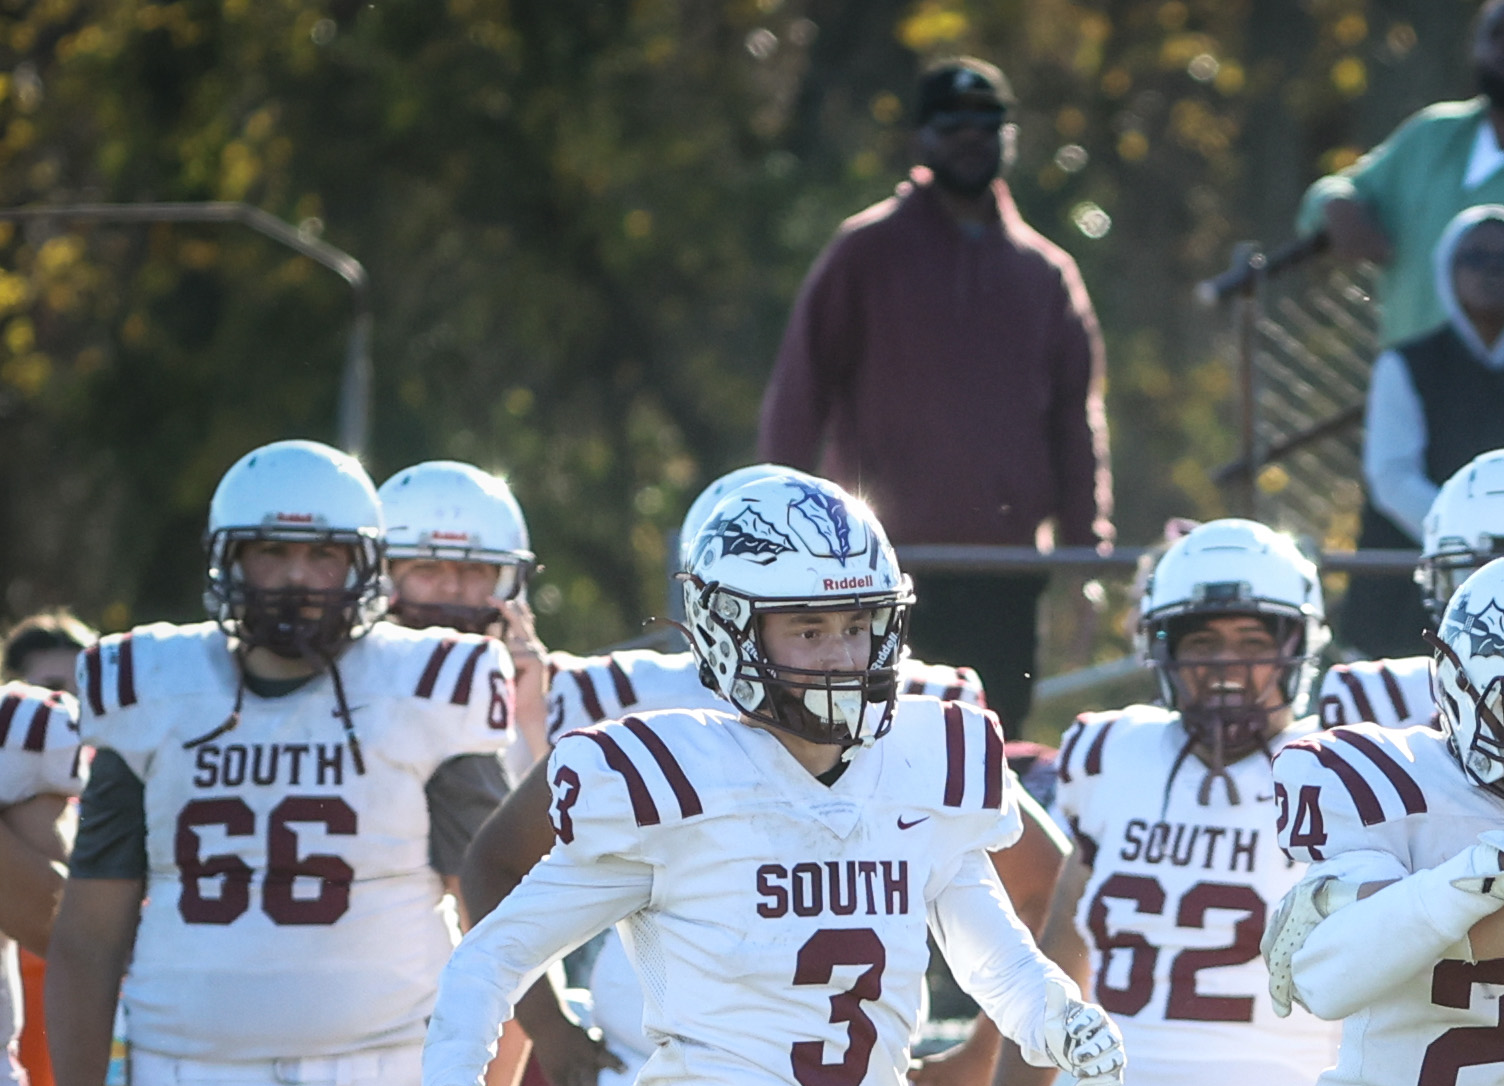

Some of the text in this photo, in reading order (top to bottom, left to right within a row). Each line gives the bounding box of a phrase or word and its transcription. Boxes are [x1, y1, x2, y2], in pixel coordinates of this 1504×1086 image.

[823, 575, 873, 591] Riddell
[870, 631, 898, 671] Riddell
[193, 744, 343, 788] SOUTH
[550, 765, 581, 845] 3
[175, 796, 357, 925] 66
[1120, 817, 1259, 872] SOUTH
[756, 860, 909, 919] SOUTH
[1086, 870, 1268, 1023] 62
